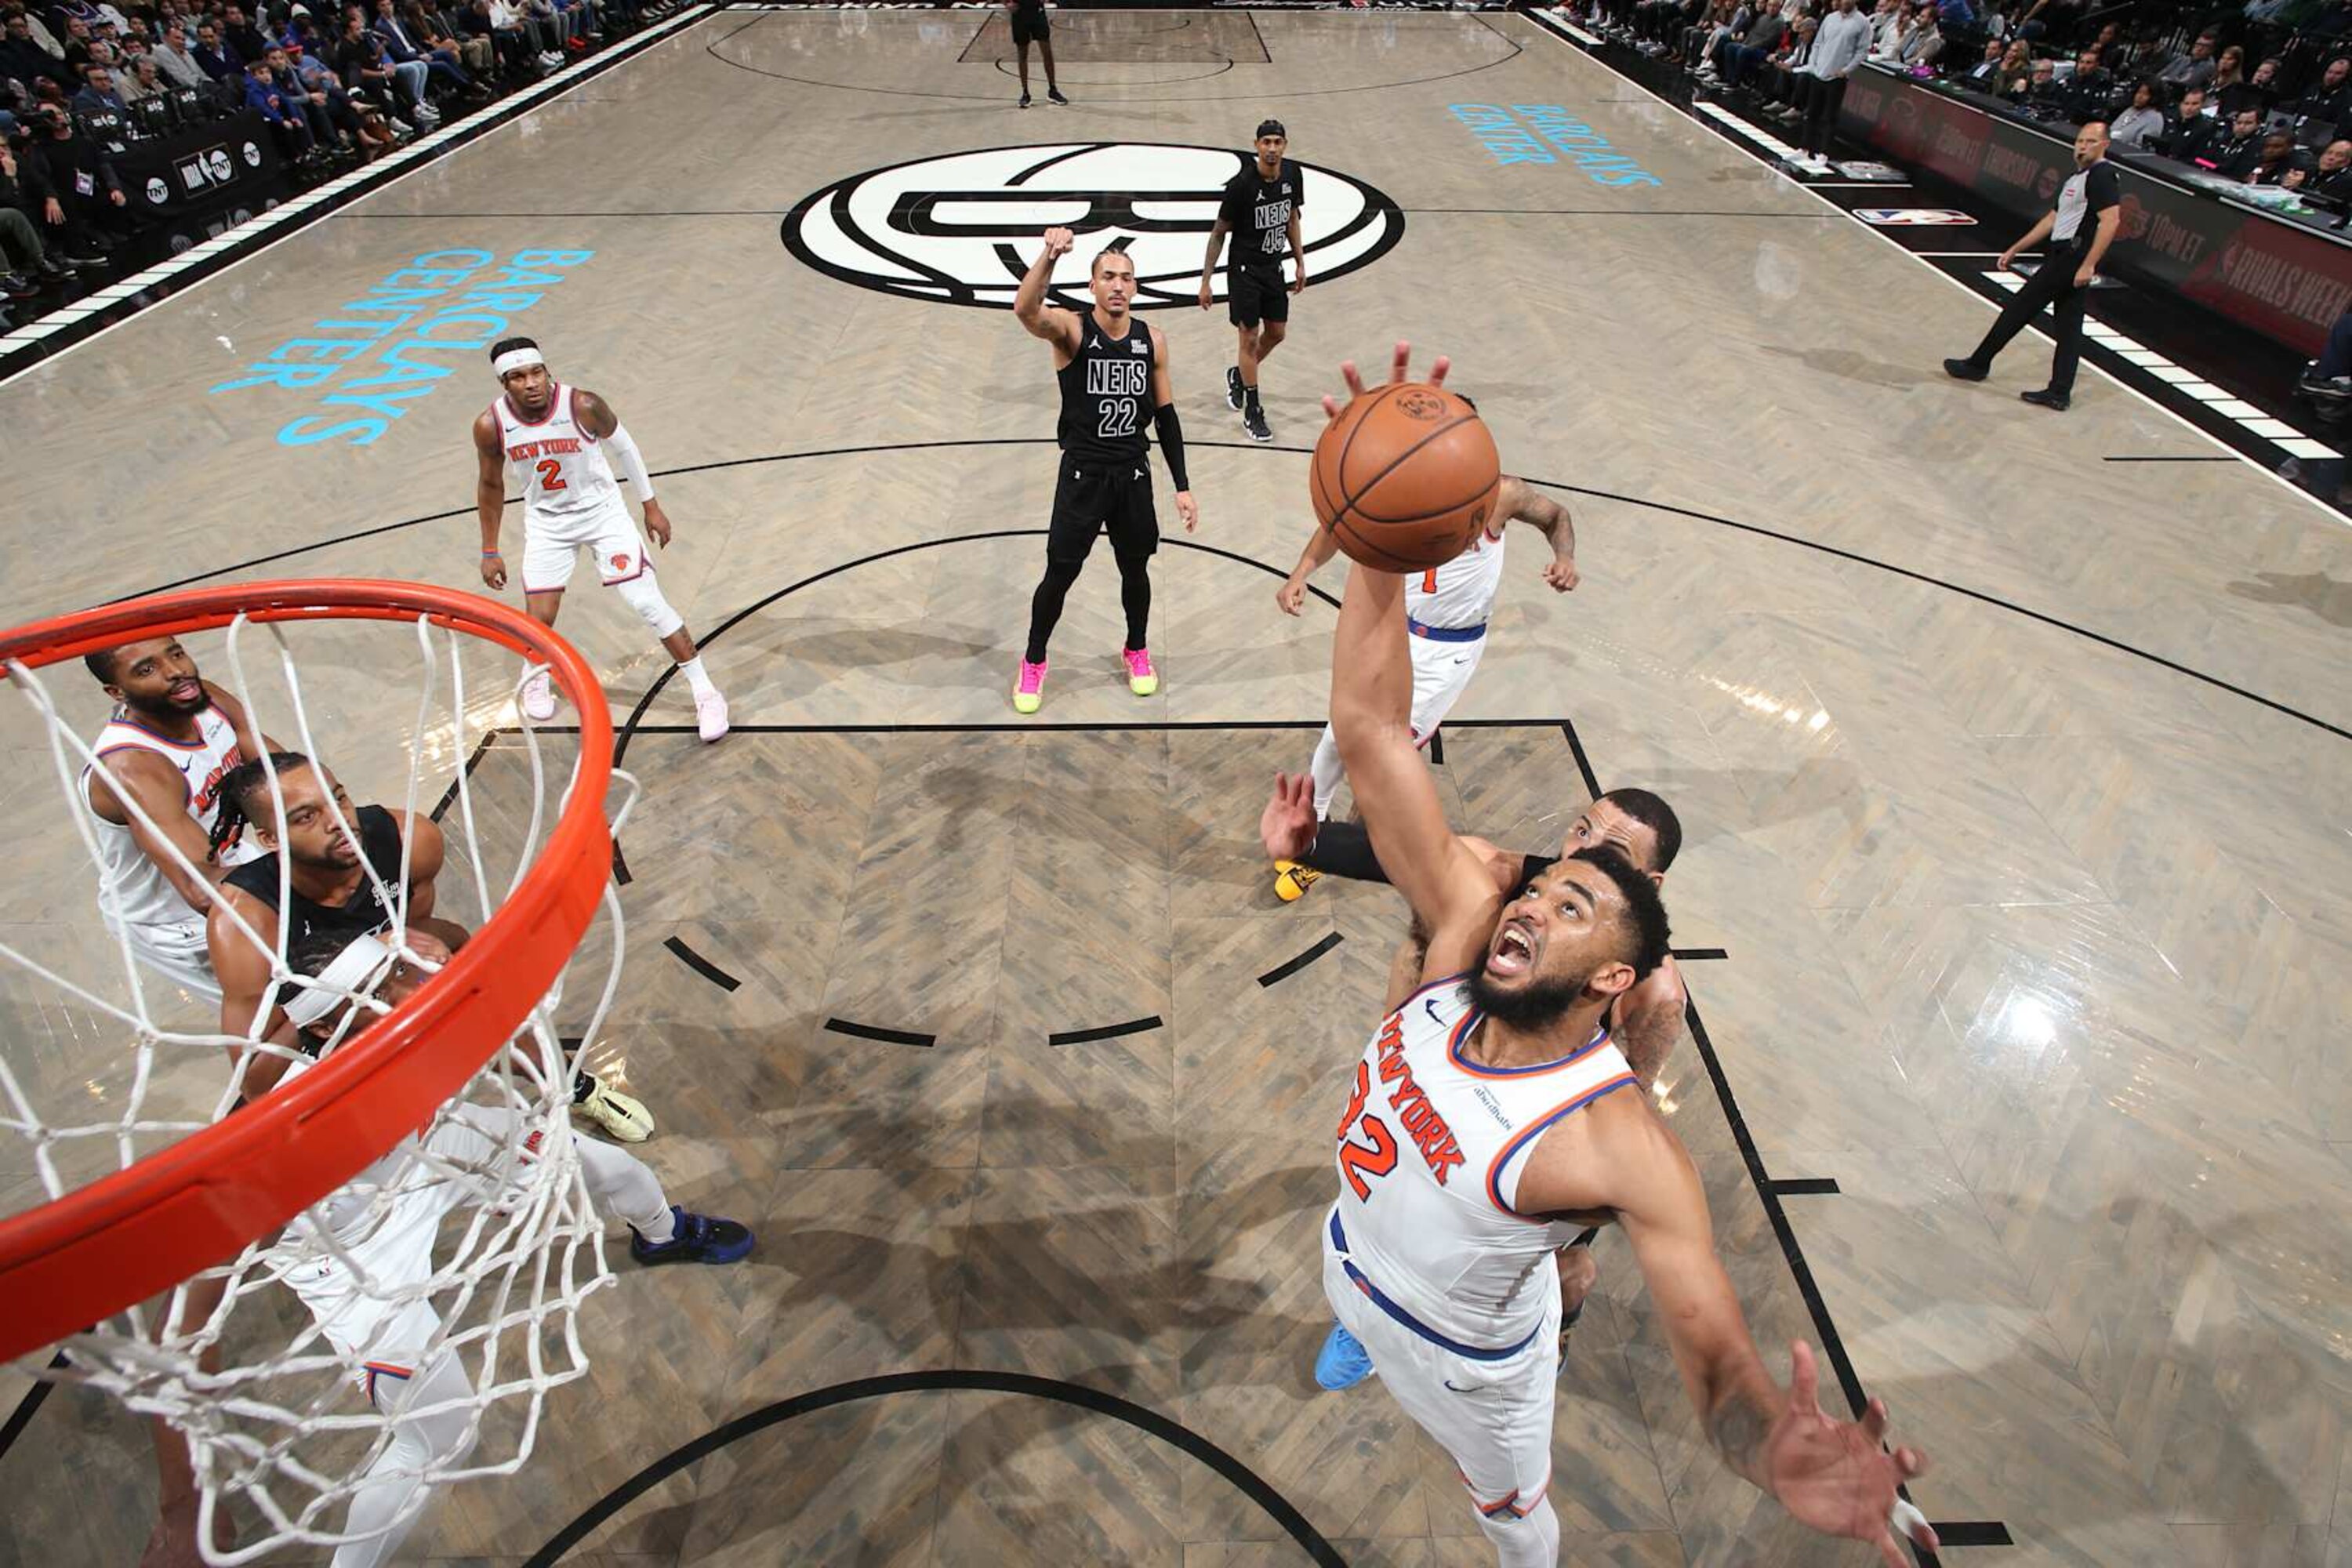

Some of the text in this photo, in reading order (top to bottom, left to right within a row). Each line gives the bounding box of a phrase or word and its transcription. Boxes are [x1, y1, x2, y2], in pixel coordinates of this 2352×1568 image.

[725, 2, 935, 10] Brooklyn
[1450, 104, 1557, 165] CENTER
[1510, 104, 1662, 186] BARCLAYS
[1254, 199, 1292, 230] NETS
[1261, 226, 1287, 254] 45
[2228, 246, 2299, 308] RIVALS
[209, 249, 494, 394] CENTER
[275, 249, 596, 447] BARCLAYS
[1087, 358, 1148, 395] NETS
[1098, 398, 1137, 437] 22
[506, 438, 582, 463] NEW YORK
[536, 459, 568, 491] 2
[1388, 1066, 1466, 1187] YORK
